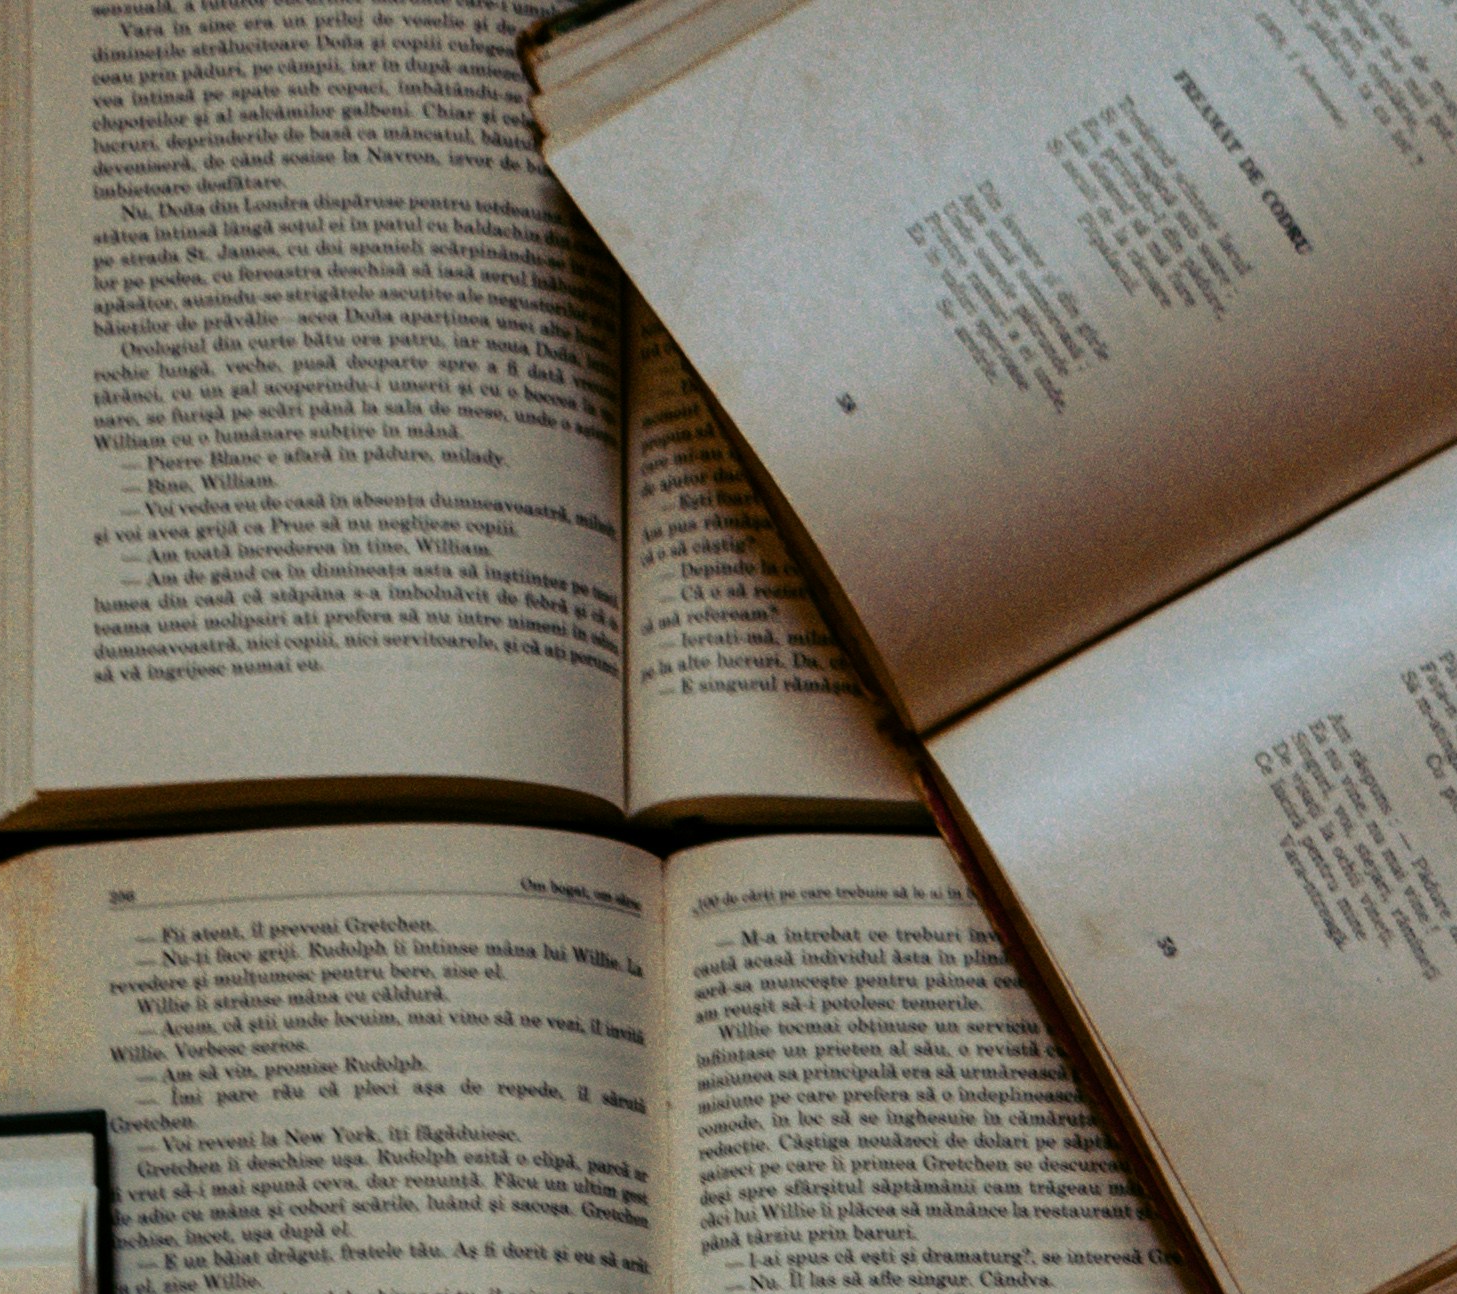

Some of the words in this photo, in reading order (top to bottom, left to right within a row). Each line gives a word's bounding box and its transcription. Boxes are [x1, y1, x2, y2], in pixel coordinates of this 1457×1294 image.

[146, 477, 194, 496] Bine,
[199, 472, 276, 491] William.
[161, 1135, 193, 1154] Voi
[197, 1135, 257, 1152] reveni
[260, 1129, 280, 1149] la
[283, 1127, 326, 1147] New
[330, 1124, 384, 1145] York,
[387, 1125, 411, 1144] îți
